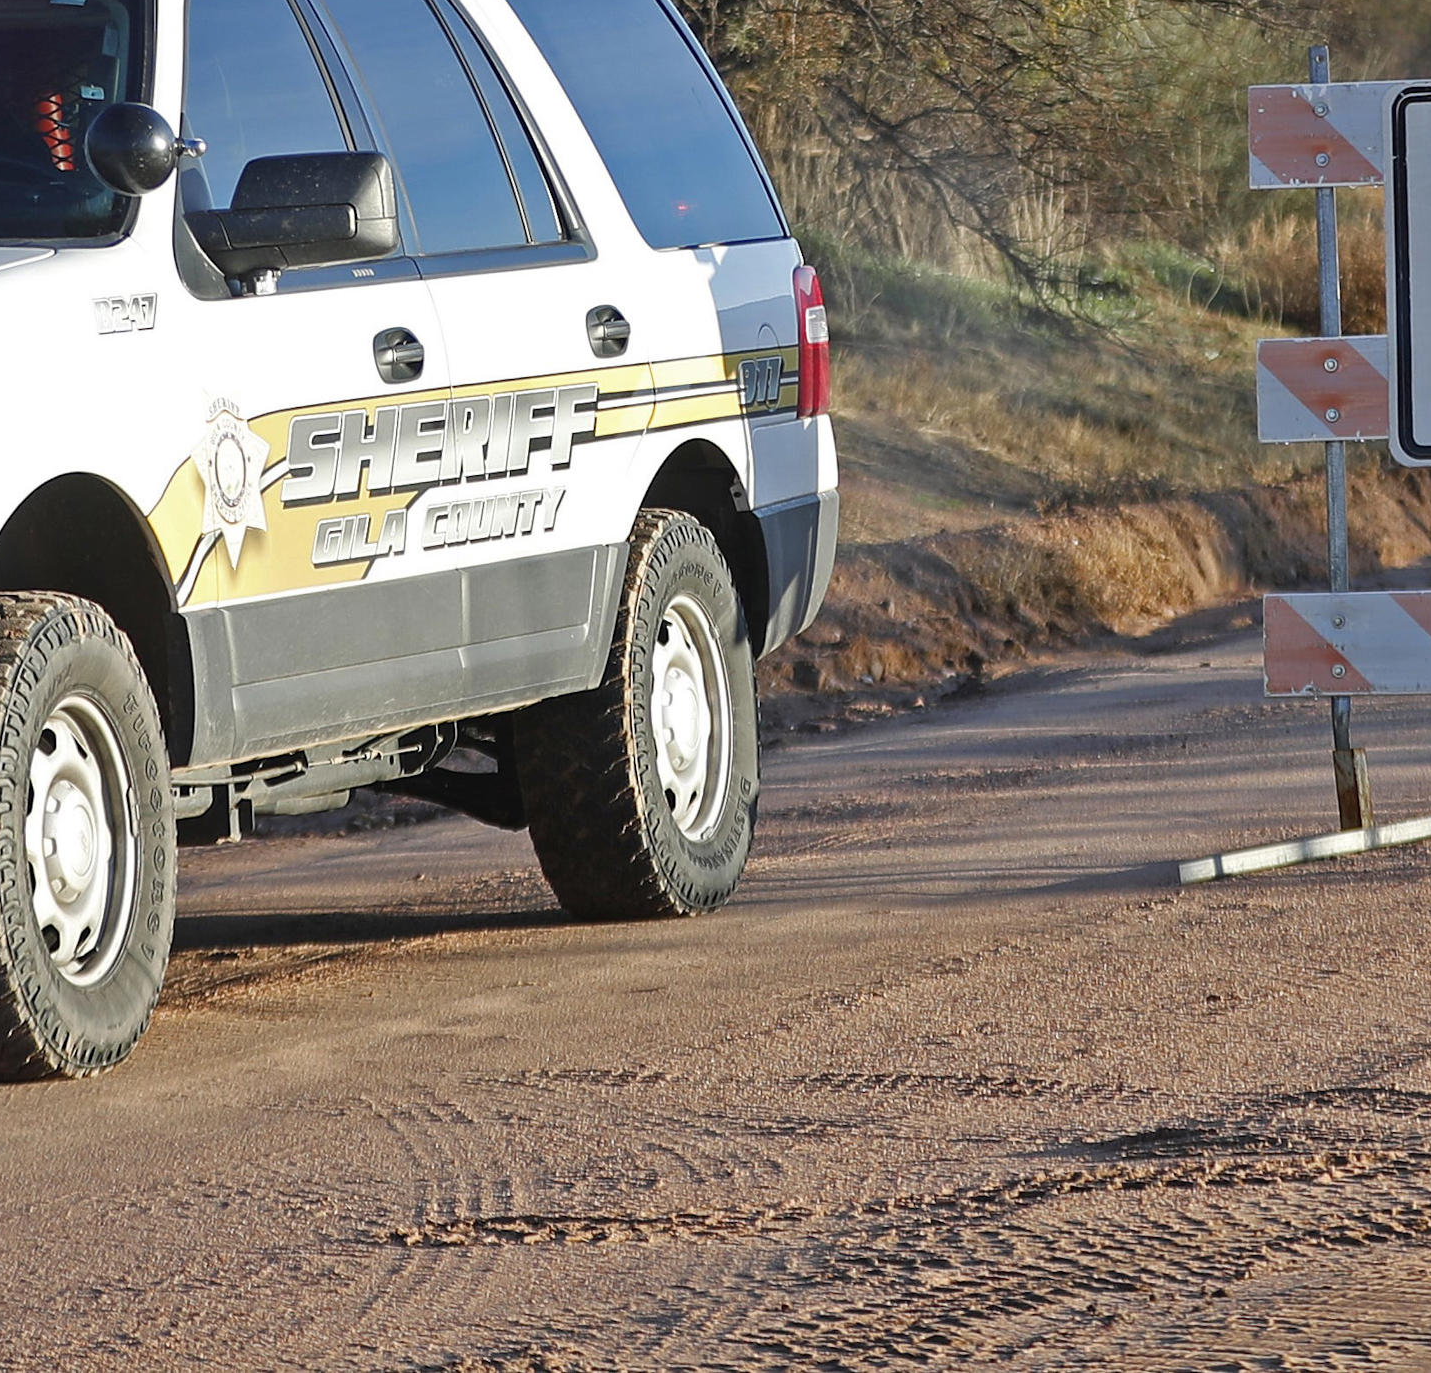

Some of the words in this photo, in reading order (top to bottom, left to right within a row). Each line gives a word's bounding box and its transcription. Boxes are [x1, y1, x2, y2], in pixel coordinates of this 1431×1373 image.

[737, 355, 783, 408] 911
[280, 381, 599, 509] SHERIFF
[312, 507, 407, 569] GILA
[422, 486, 566, 550] COUNTY
